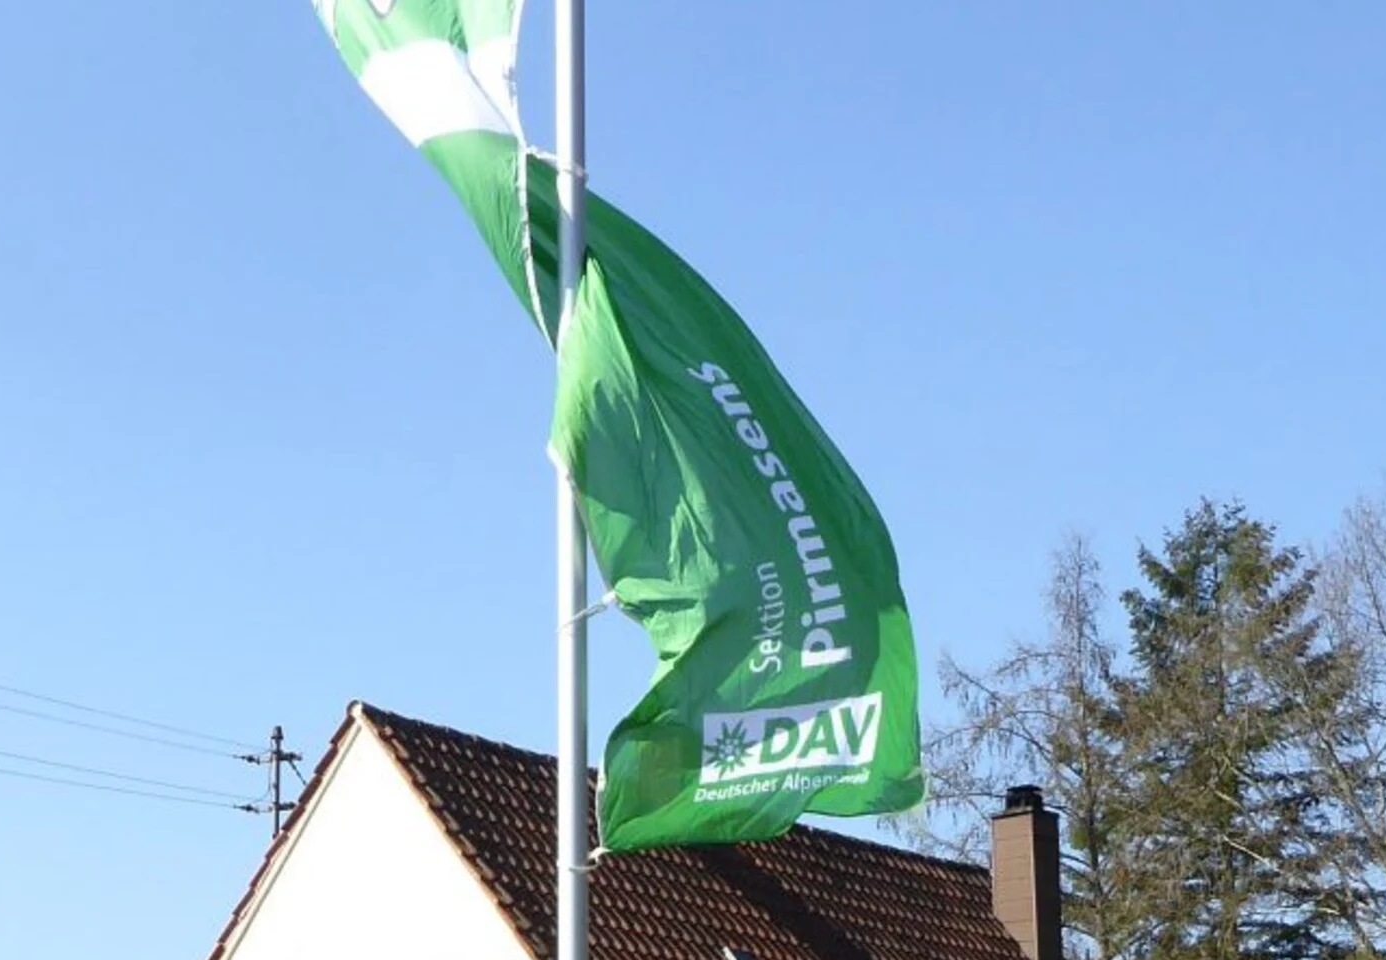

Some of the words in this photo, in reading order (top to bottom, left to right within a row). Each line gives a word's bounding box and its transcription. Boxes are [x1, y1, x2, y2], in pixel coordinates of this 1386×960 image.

[687, 361, 852, 669] Pirmasens
[749, 561, 785, 675] Sektion
[757, 702, 877, 766] DAV
[693, 777, 779, 803] Deutscher
